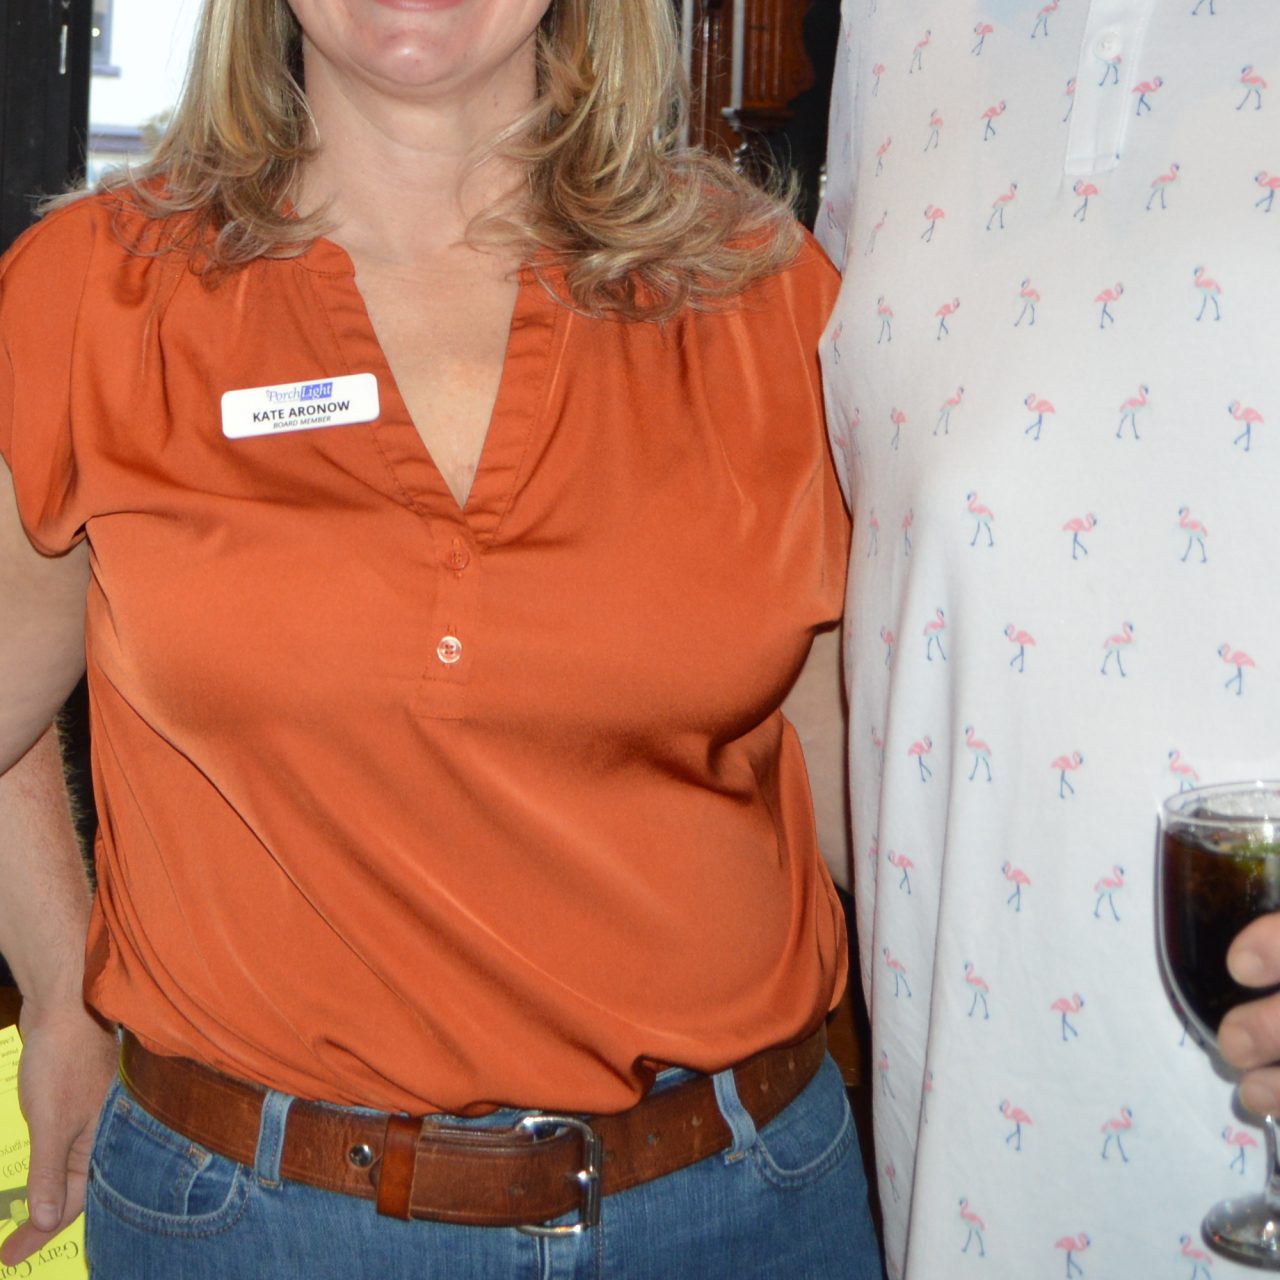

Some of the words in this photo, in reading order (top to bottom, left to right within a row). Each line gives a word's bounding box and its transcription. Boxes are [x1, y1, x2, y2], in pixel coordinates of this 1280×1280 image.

[252, 408, 285, 423] KATE
[288, 400, 351, 418] ARONOW
[273, 419, 298, 429] BOARD
[300, 416, 331, 425] MEMBER
[1, 1158, 29, 1178] 303)
[37, 1241, 79, 1265] Gary
